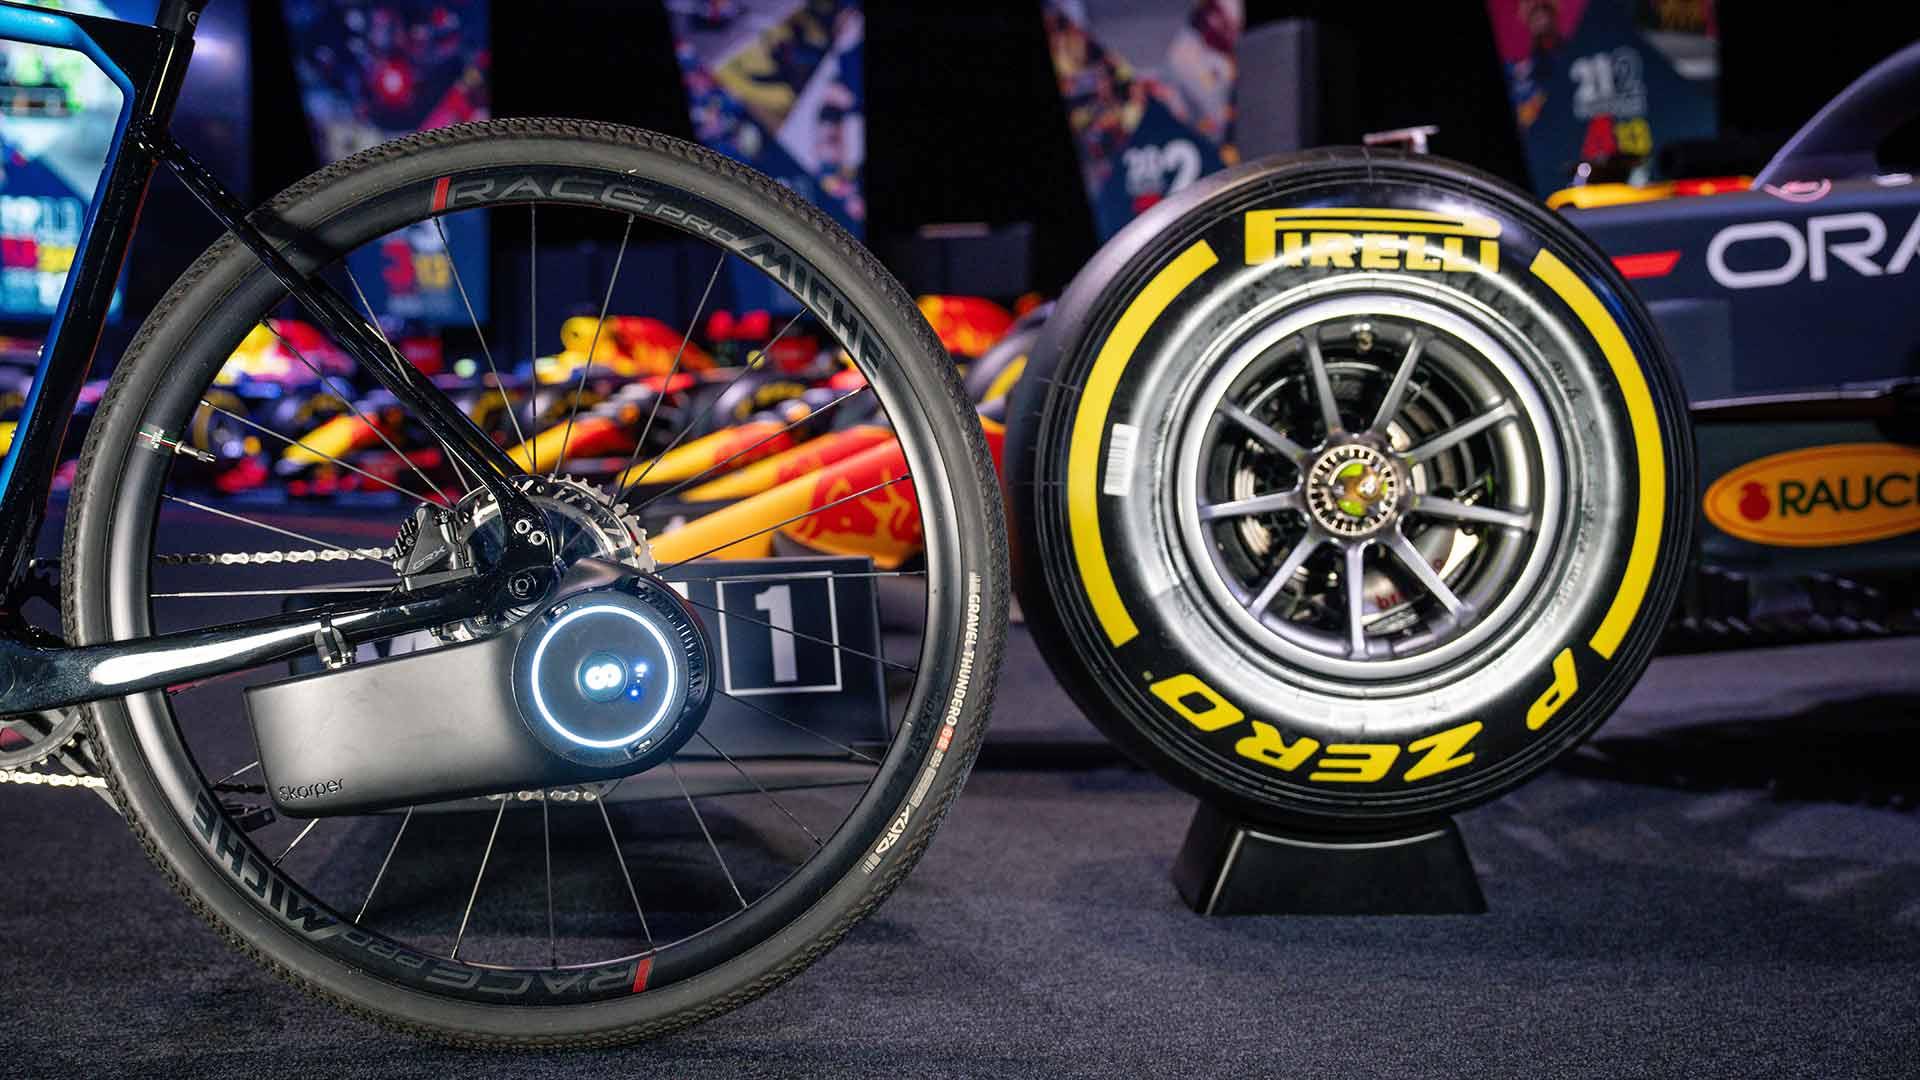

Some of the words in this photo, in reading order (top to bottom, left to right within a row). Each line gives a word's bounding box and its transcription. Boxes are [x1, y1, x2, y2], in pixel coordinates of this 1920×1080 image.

[451, 176, 650, 209] RACE
[656, 204, 740, 243] PRO
[740, 238, 883, 379] MICHE
[1244, 207, 1501, 273] PIRELLI
[1778, 471, 1920, 517] RAUC
[755, 584, 798, 683] 1
[963, 593, 981, 649] GRAVEL
[945, 650, 975, 727] THUNDERO
[1526, 647, 1579, 730] P
[1149, 673, 1484, 783] ZERO
[279, 778, 344, 801] Skarper
[193, 793, 337, 932] MICHE
[425, 958, 637, 995] RACE
